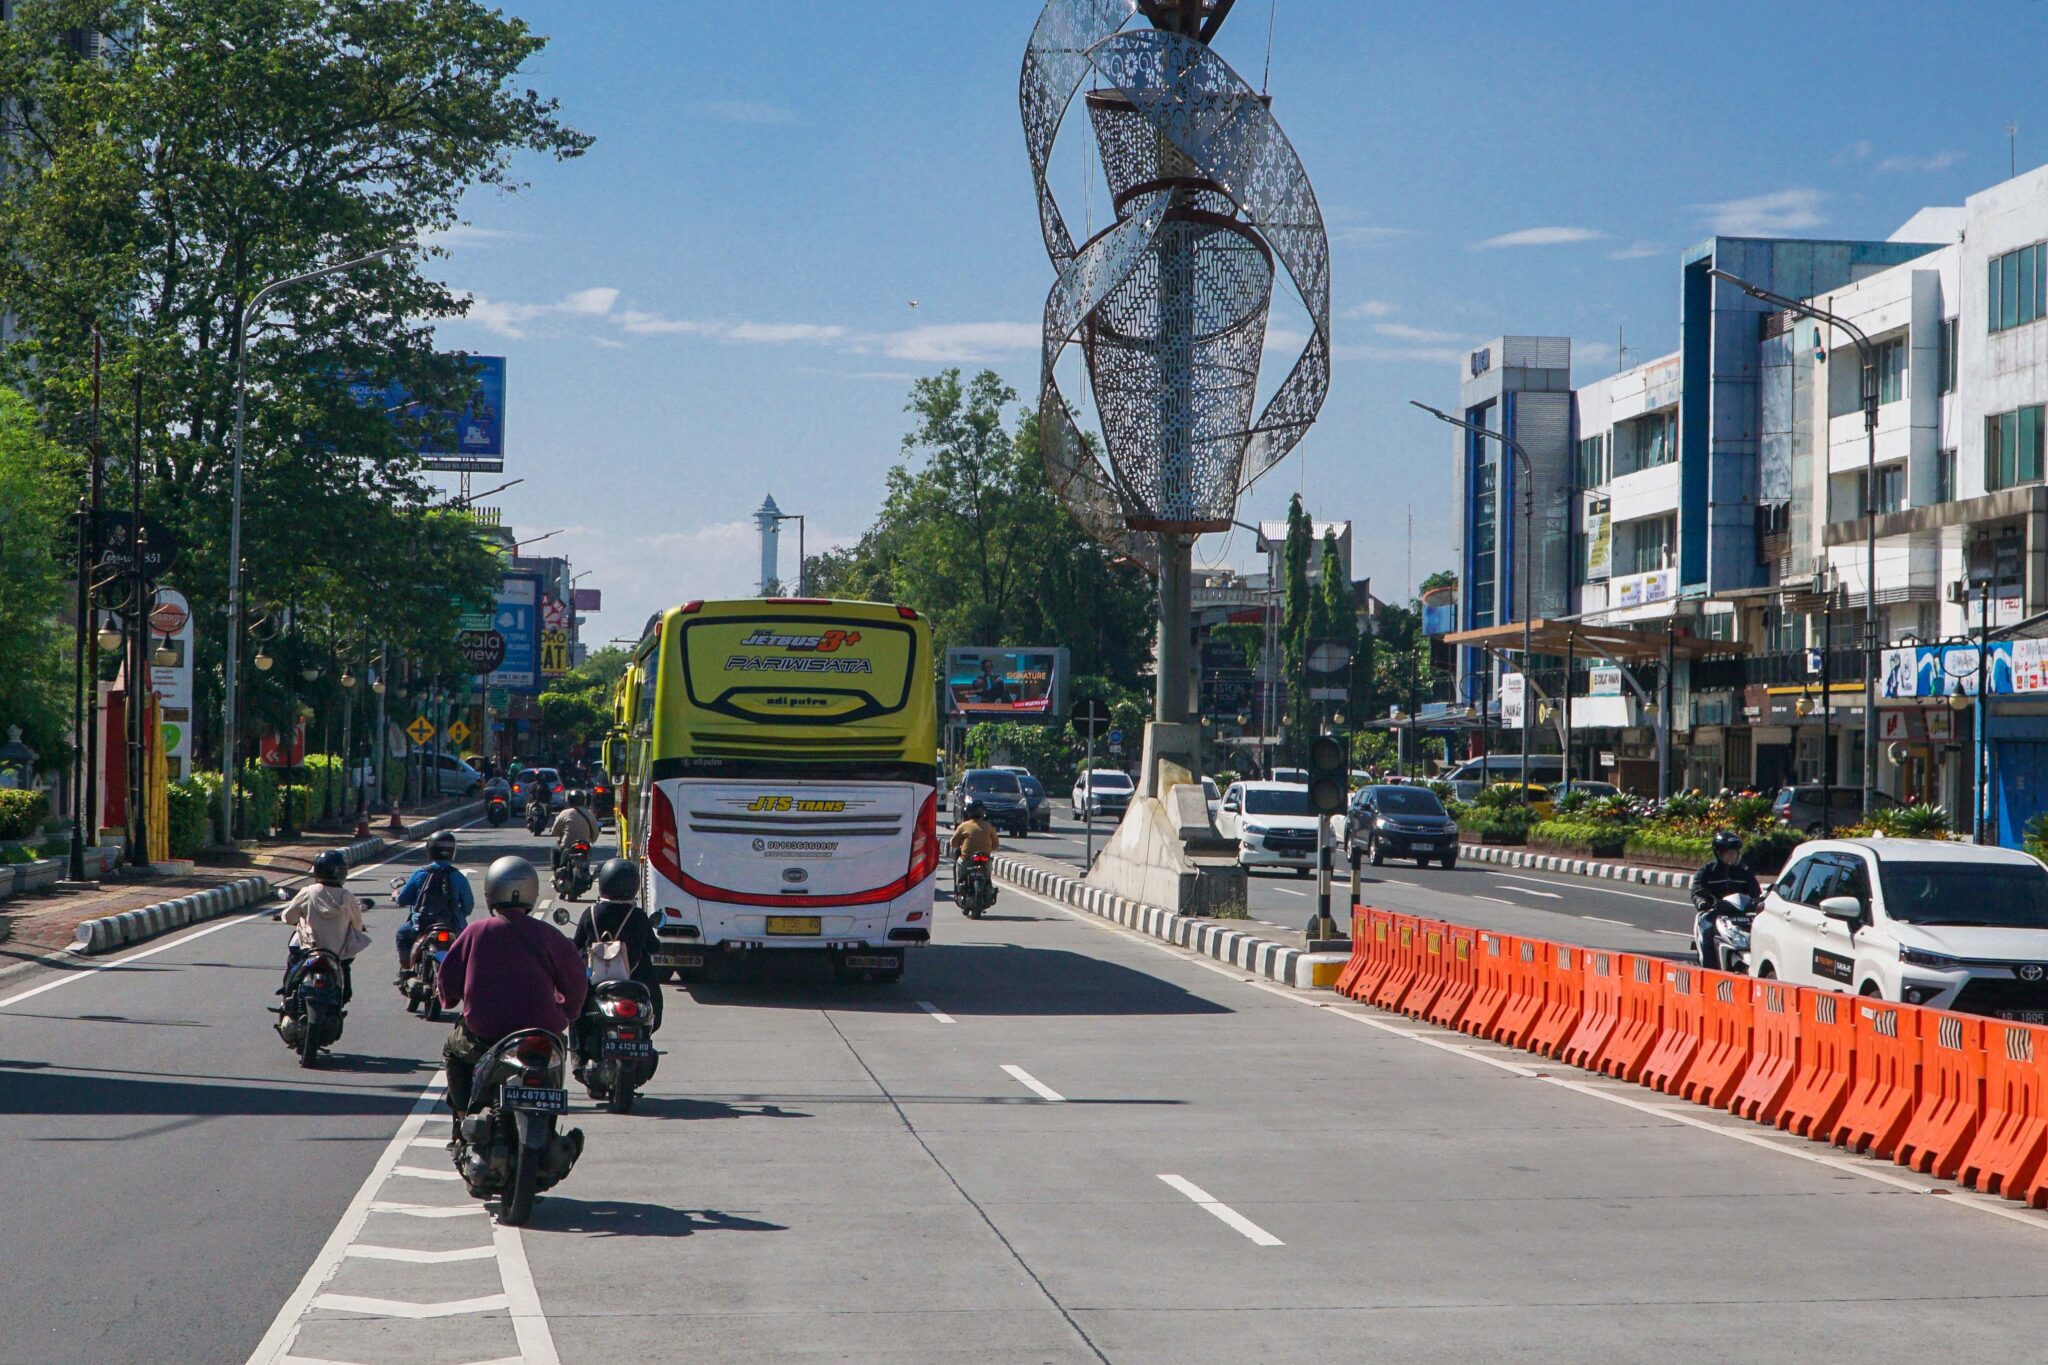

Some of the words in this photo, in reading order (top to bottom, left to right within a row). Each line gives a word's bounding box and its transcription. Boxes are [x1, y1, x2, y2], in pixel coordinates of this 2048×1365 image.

[741, 635, 822, 646] JETBUS
[463, 648, 499, 660] view
[725, 656, 872, 673] PARIWISATA
[1006, 671, 1047, 679] SIGNATURE
[790, 697, 827, 706] putro
[748, 796, 793, 812] JTS
[797, 801, 846, 812] TRANS
